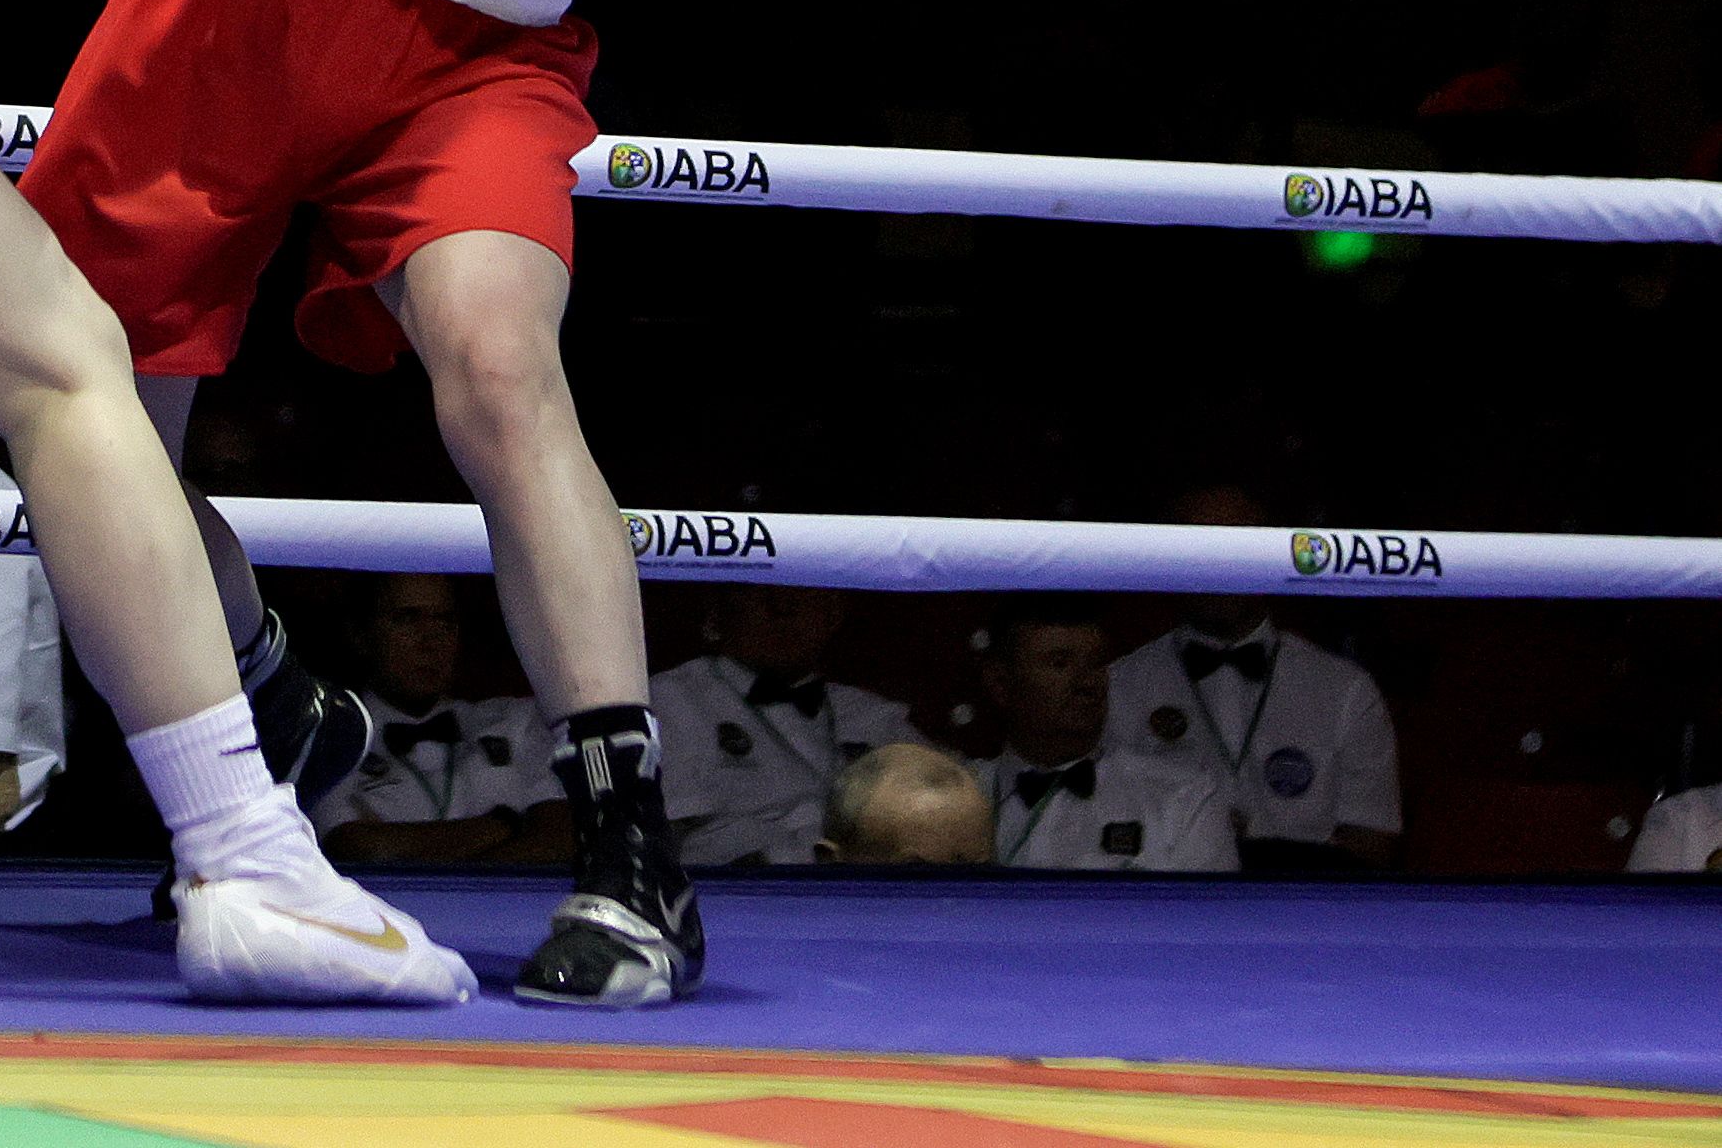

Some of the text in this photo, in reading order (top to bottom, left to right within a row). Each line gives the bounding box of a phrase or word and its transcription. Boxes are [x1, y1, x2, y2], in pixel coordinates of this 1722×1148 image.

[651, 147, 770, 194] IABA
[1323, 176, 1433, 220] IABA
[653, 514, 777, 558] IABA
[1330, 533, 1443, 577] IABA
